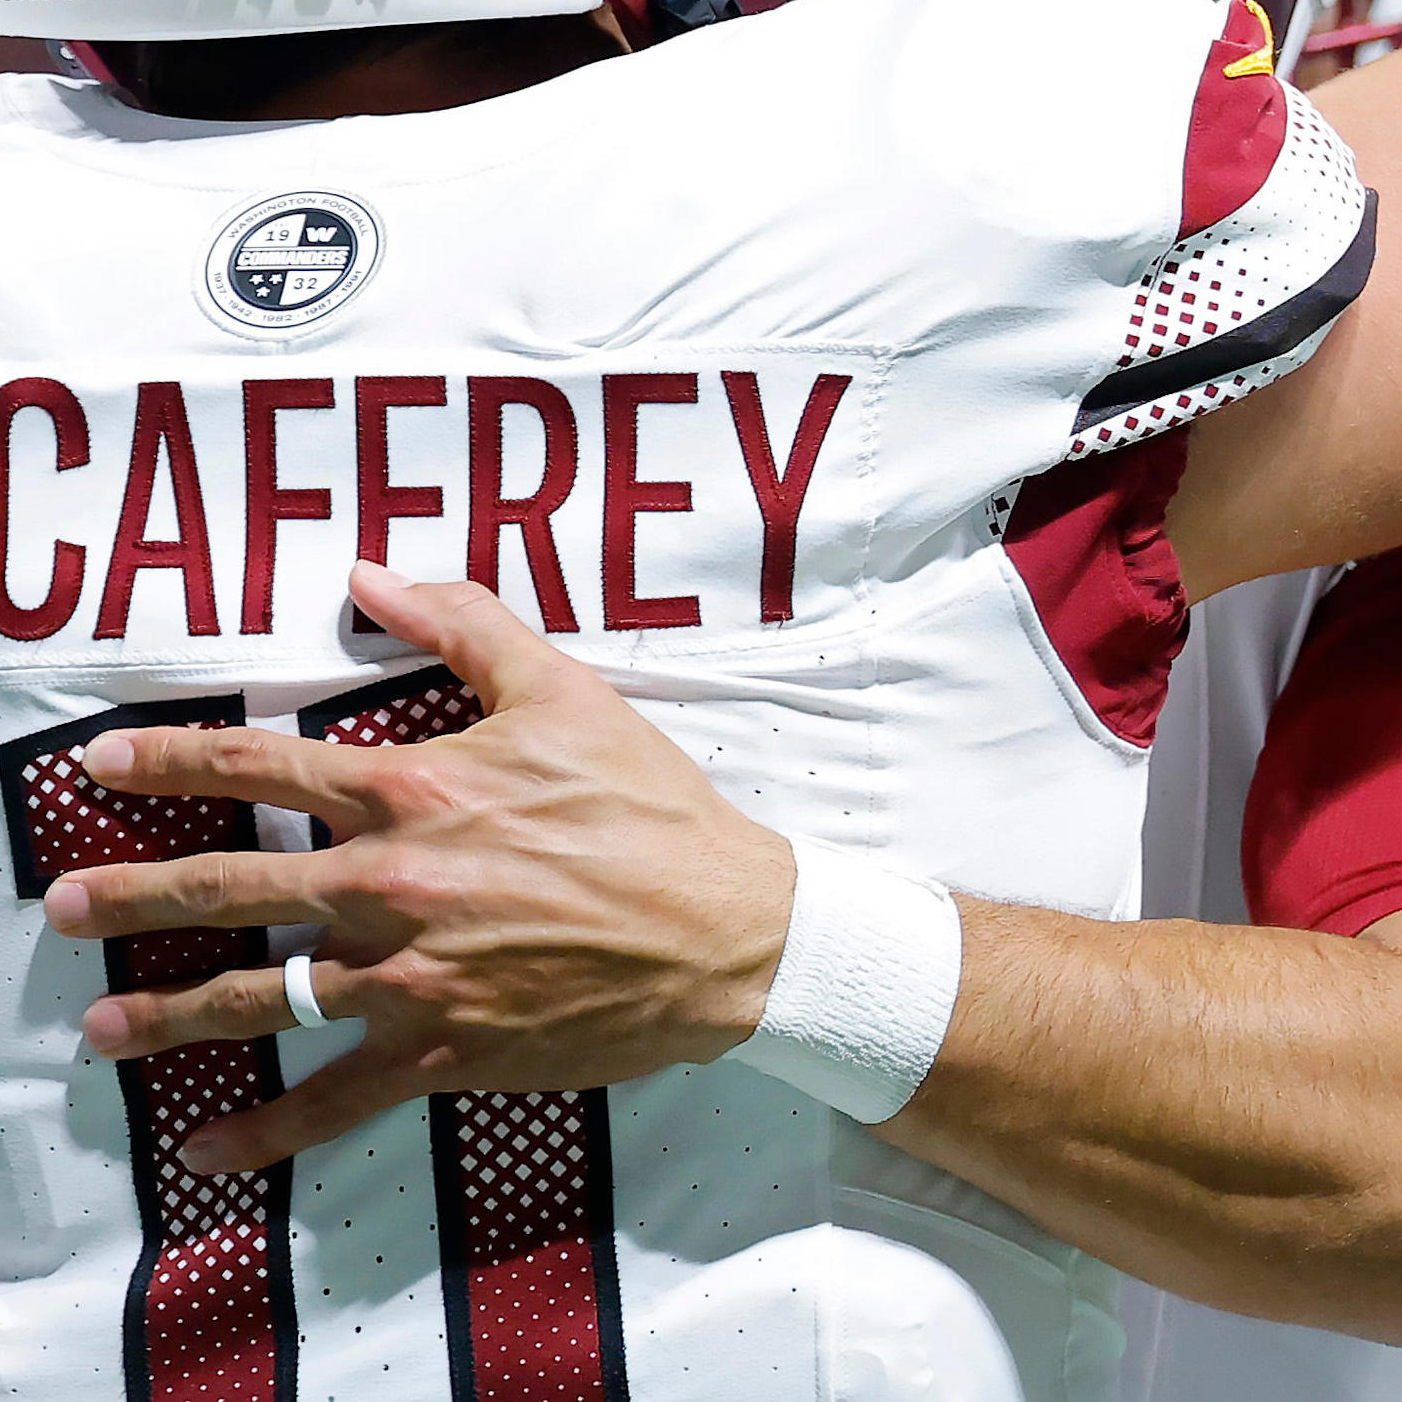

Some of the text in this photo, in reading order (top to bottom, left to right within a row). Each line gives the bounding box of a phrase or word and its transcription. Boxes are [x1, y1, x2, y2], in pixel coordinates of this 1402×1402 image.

[227, 197, 370, 239] WASHINGTON FOOTBALL
[265, 229, 290, 242] 19
[237, 250, 350, 266] COMMANDERS
[292, 277, 318, 290] 32
